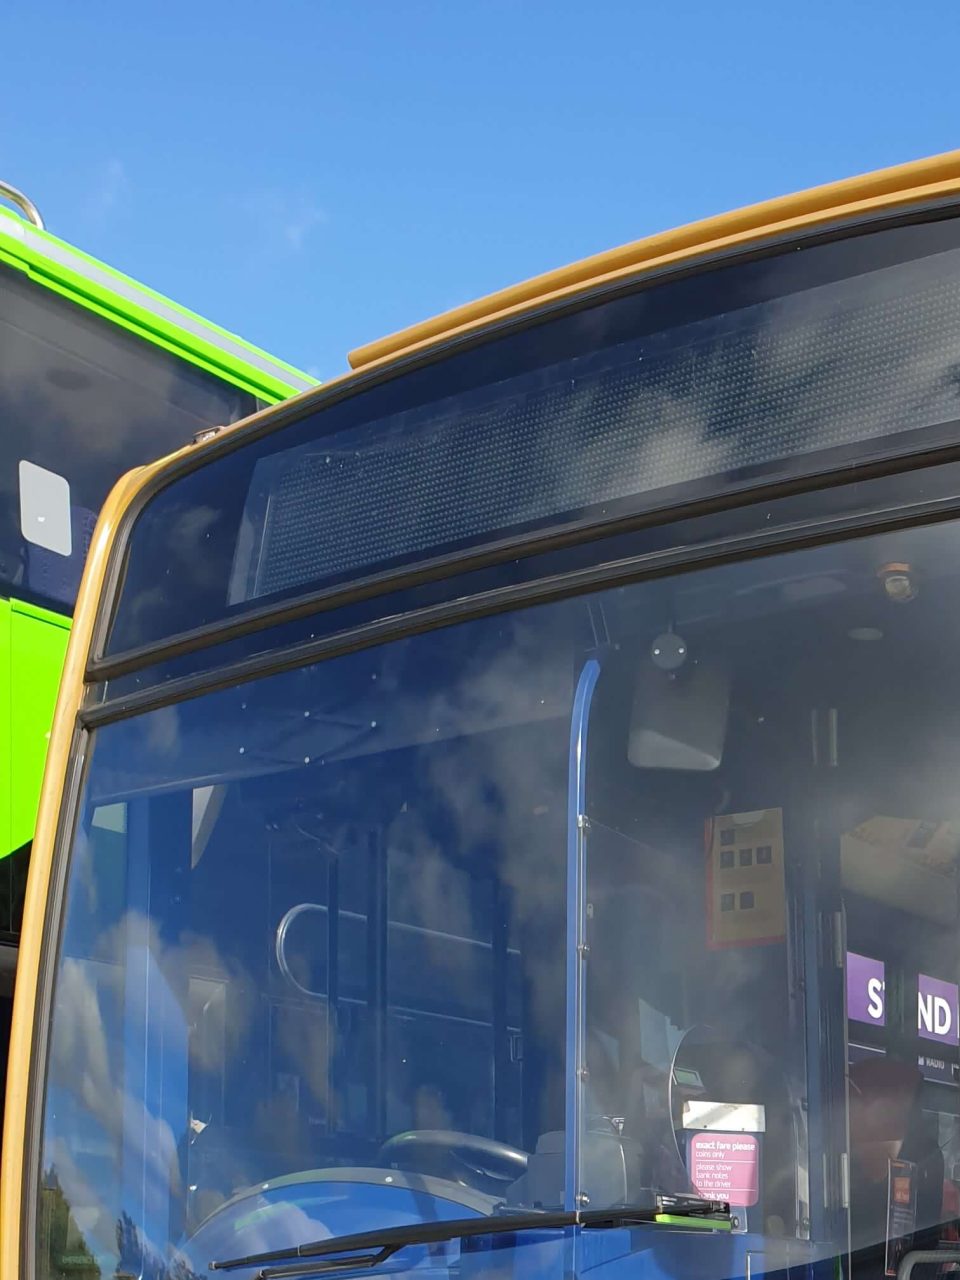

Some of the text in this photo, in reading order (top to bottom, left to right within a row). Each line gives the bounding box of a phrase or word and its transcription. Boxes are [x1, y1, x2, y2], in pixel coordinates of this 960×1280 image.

[867, 977, 952, 1035] SND
[696, 1142, 756, 1152] exact fare please
[712, 1151, 726, 1160] only
[716, 1192, 730, 1201] you
